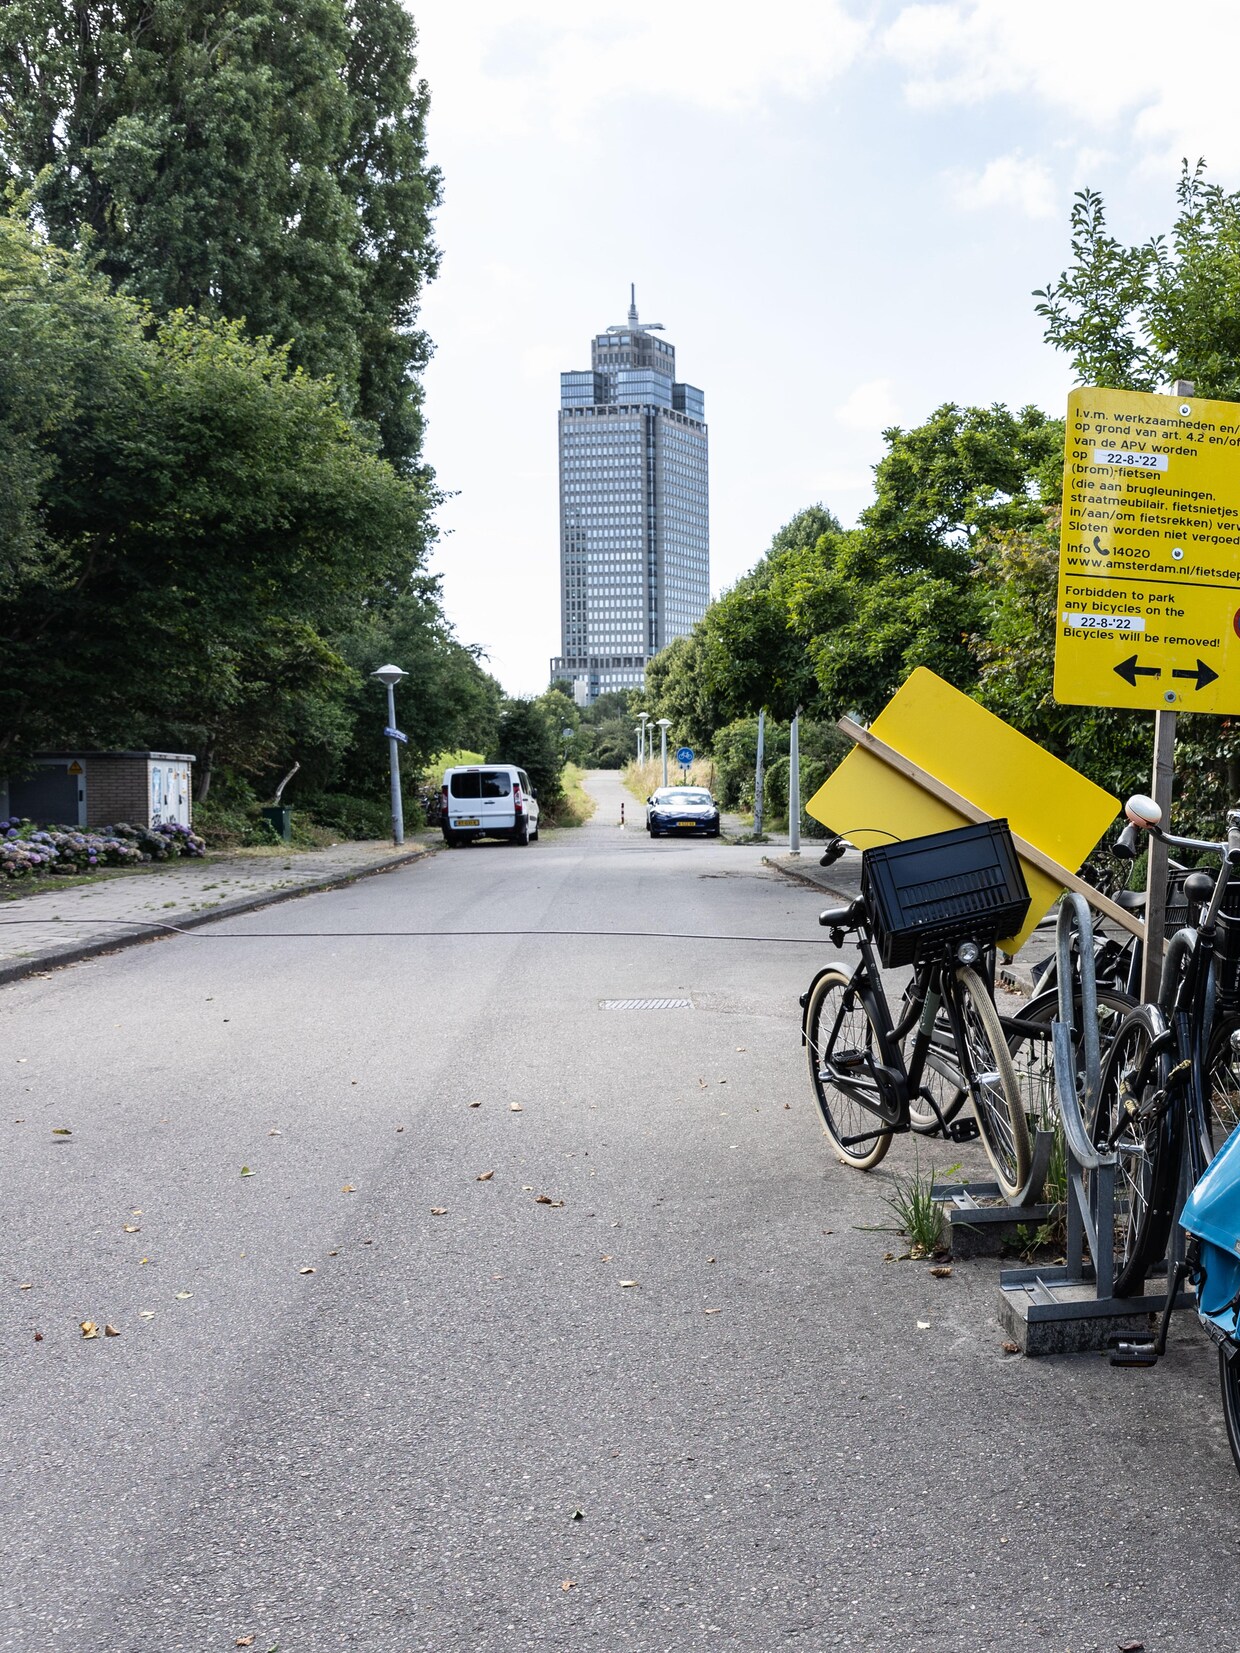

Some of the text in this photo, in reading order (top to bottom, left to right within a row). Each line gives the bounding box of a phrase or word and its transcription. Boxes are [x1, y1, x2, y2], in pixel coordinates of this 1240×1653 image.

[1076, 408, 1109, 421] I.v.m.
[1114, 412, 1215, 432] werkzaamheden
[1075, 421, 1240, 447] op grond van art. 4.2 en/of
[1074, 437, 1198, 456] van de APV worden
[1072, 449, 1157, 467] op 22-8-'22
[1071, 478, 1095, 489] (die
[1100, 482, 1121, 491] aan
[1172, 501, 1239, 517] fietsnietjes
[1070, 507, 1135, 521] in/aan/om
[1140, 513, 1213, 531] fietsrekken)
[1069, 521, 1108, 533] Sloten
[1113, 525, 1160, 538] worden
[1164, 530, 1187, 540] niet
[1067, 543, 1150, 558] Info 14020
[1065, 586, 1175, 604] Forbidden to park
[1065, 601, 1185, 617] any bicycles on the
[1081, 617, 1131, 629] 22-8-'22
[1064, 627, 1220, 648] Bicycles will be removed!
